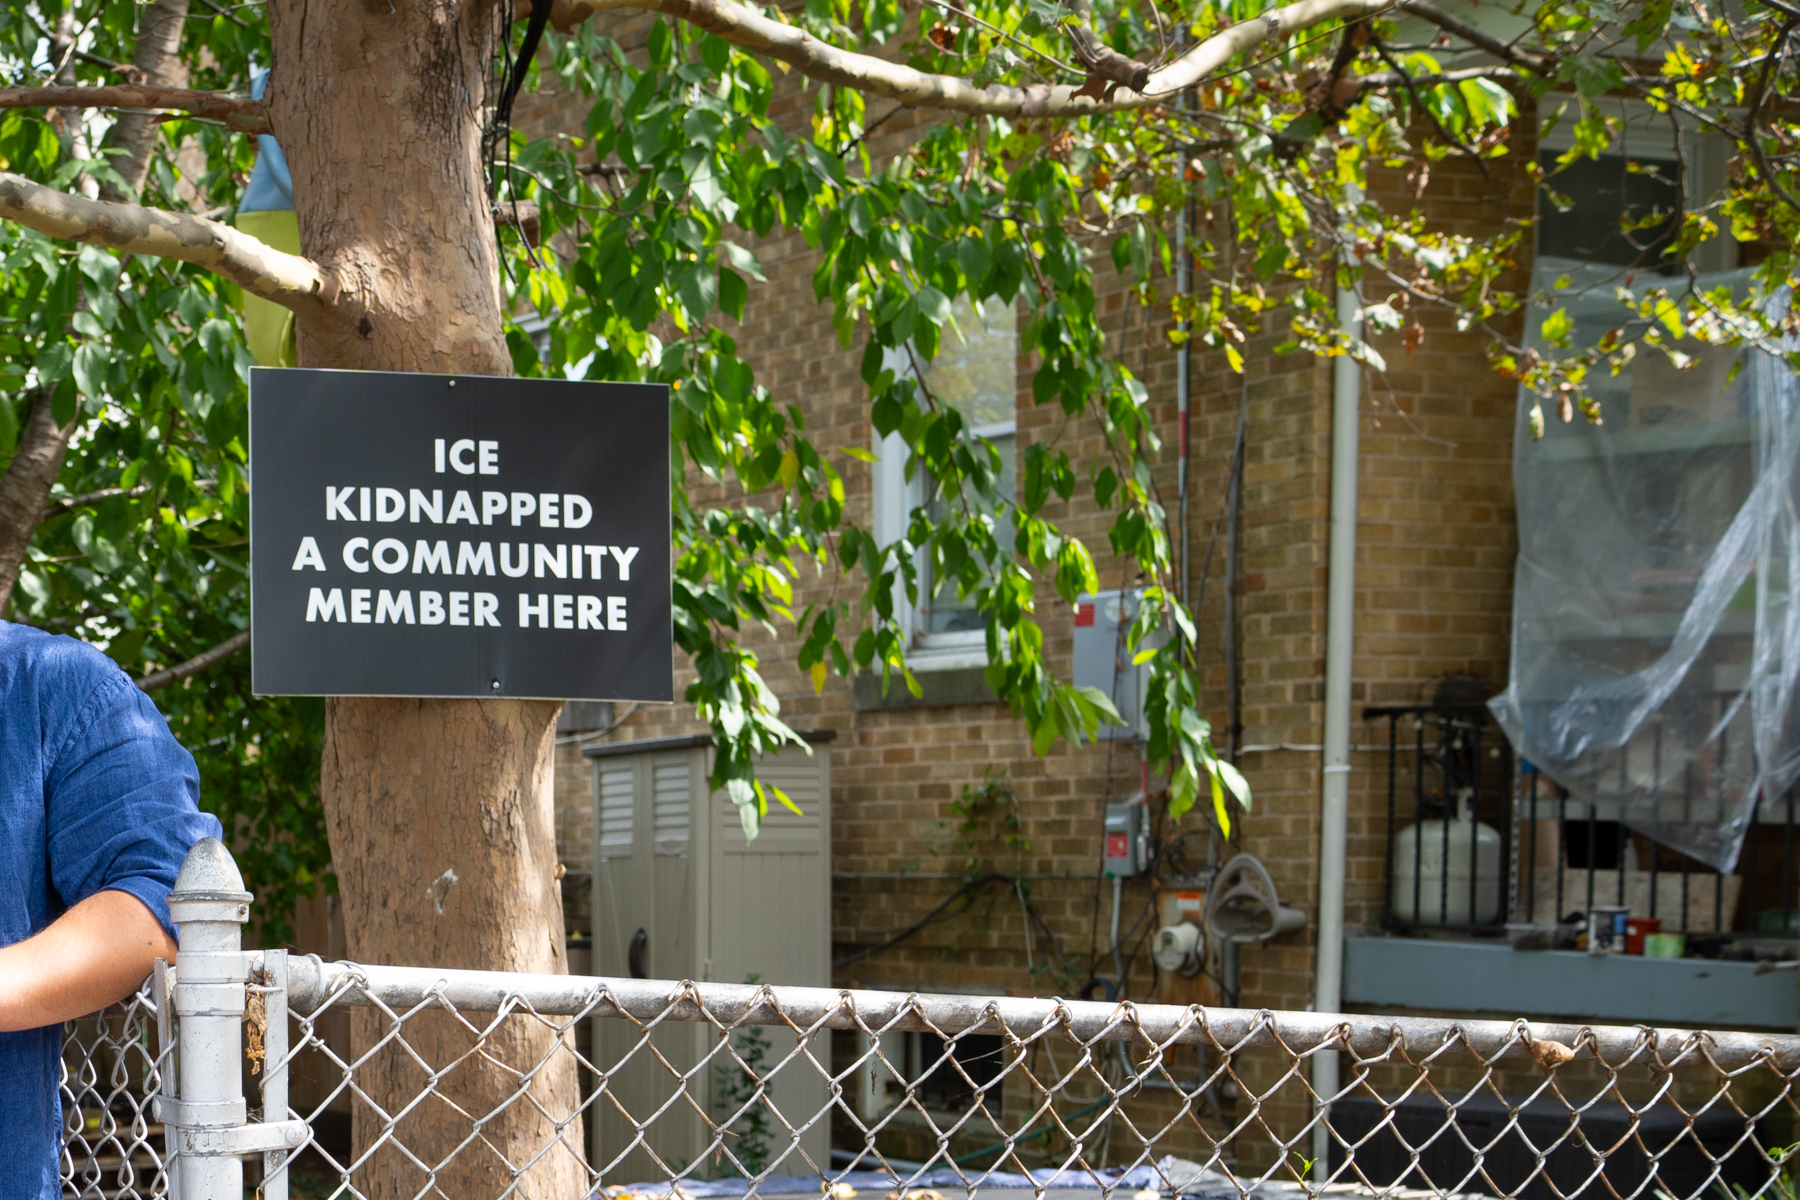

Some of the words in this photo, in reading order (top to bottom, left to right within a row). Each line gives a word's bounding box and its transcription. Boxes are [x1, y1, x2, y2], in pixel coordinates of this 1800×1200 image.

[434, 438, 499, 475] ICE
[325, 485, 593, 529] KIDNAPPED
[291, 536, 327, 572] A
[342, 536, 640, 581] COMMUNITY
[305, 587, 502, 627] MEMBER
[518, 593, 628, 632] HERE
